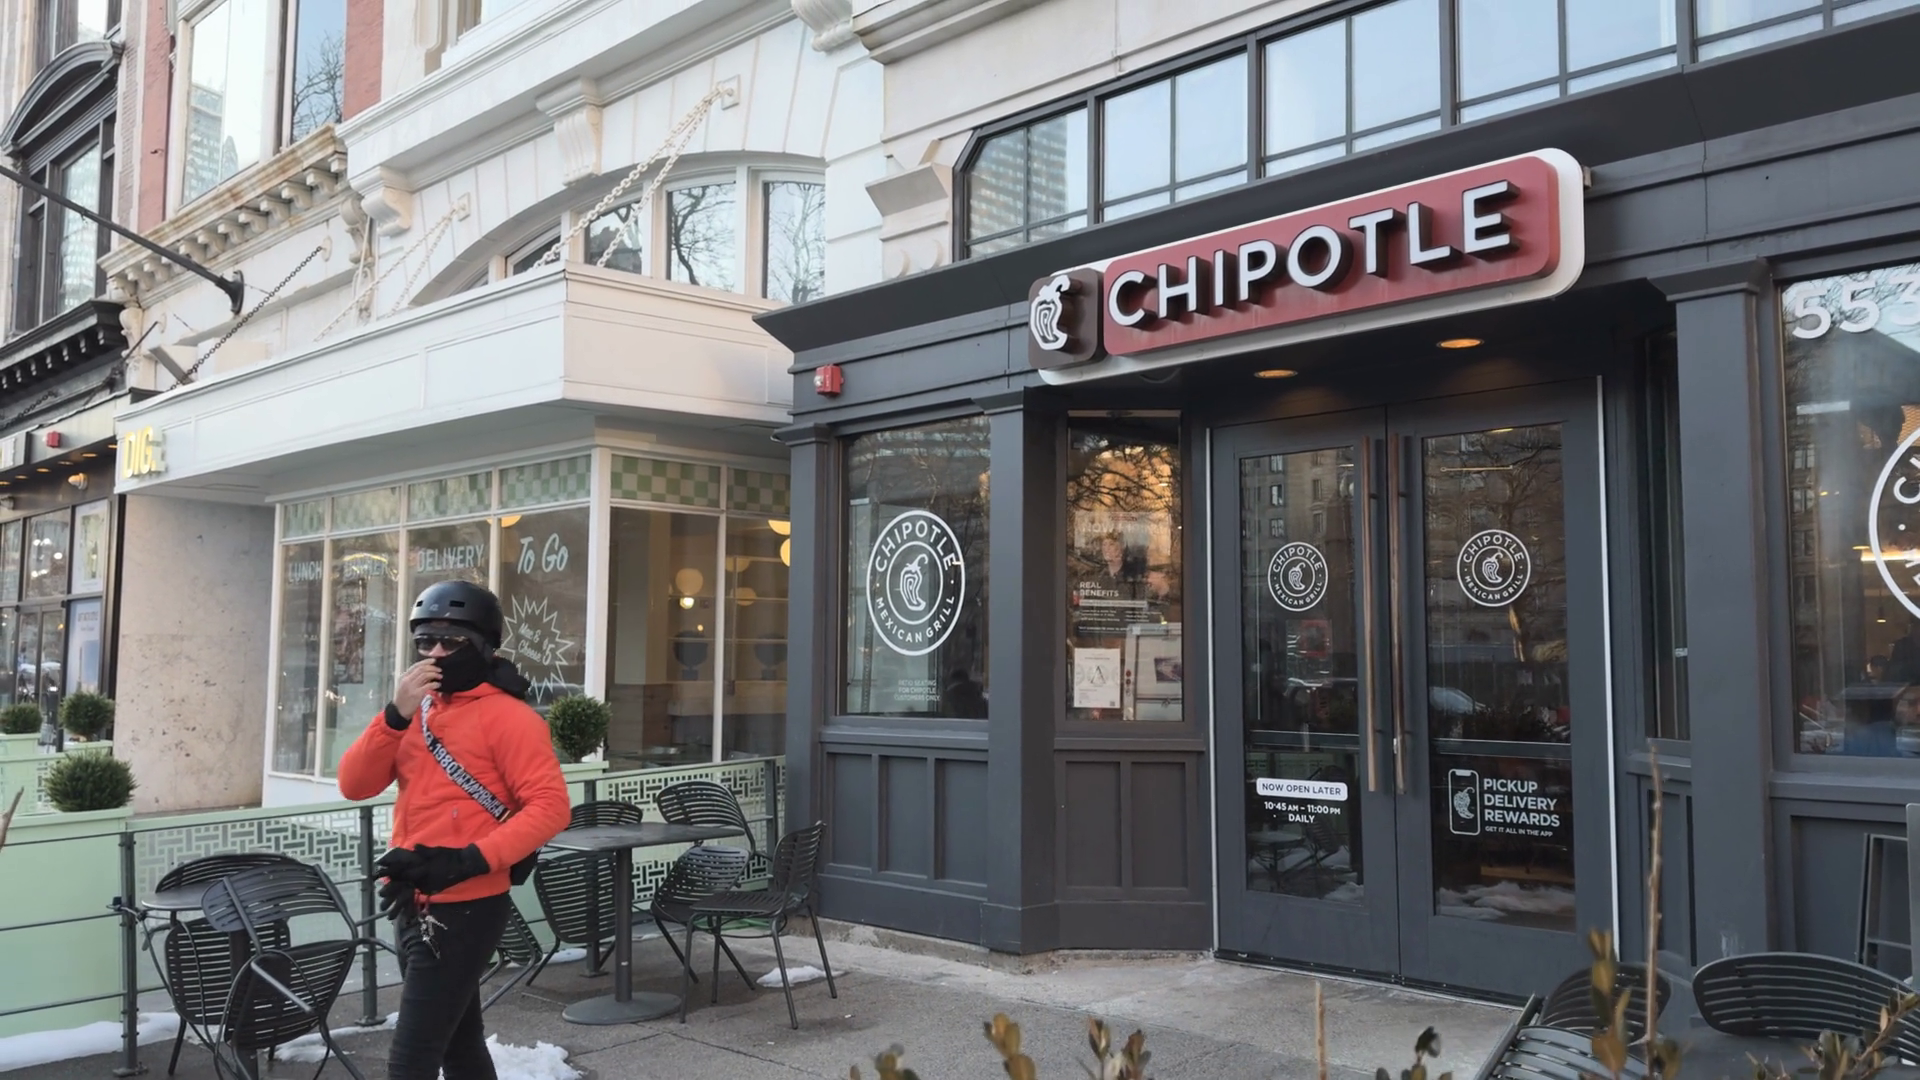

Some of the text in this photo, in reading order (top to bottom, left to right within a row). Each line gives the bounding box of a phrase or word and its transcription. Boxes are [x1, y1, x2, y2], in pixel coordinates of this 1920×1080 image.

[1108, 180, 1515, 327] CHIPOTLE
[1792, 275, 1920, 339] 553
[518, 533, 569, 574] To Go
[875, 520, 957, 572] CHIPOTLE
[1463, 535, 1525, 562] CHIPOTLE
[417, 544, 485, 572] DELIVERY
[1273, 546, 1323, 572] CHIPOTLE
[289, 561, 323, 582] LUNCH
[1080, 581, 1101, 589] REAL
[1080, 589, 1119, 597] BENEFITS
[1275, 582, 1322, 605] MEXICAN GRILL
[1465, 574, 1524, 599] MEXICAN GRILL
[876, 595, 955, 643] MEXICAN GRILL
[1262, 783, 1341, 795] NOW OPEN LATER
[1483, 778, 1538, 793] PICKUP
[1307, 804, 1329, 814] 11:00
[1484, 793, 1557, 811] DELIVERY
[1288, 813, 1315, 823] DAILY
[1484, 809, 1560, 827] REWARDS
